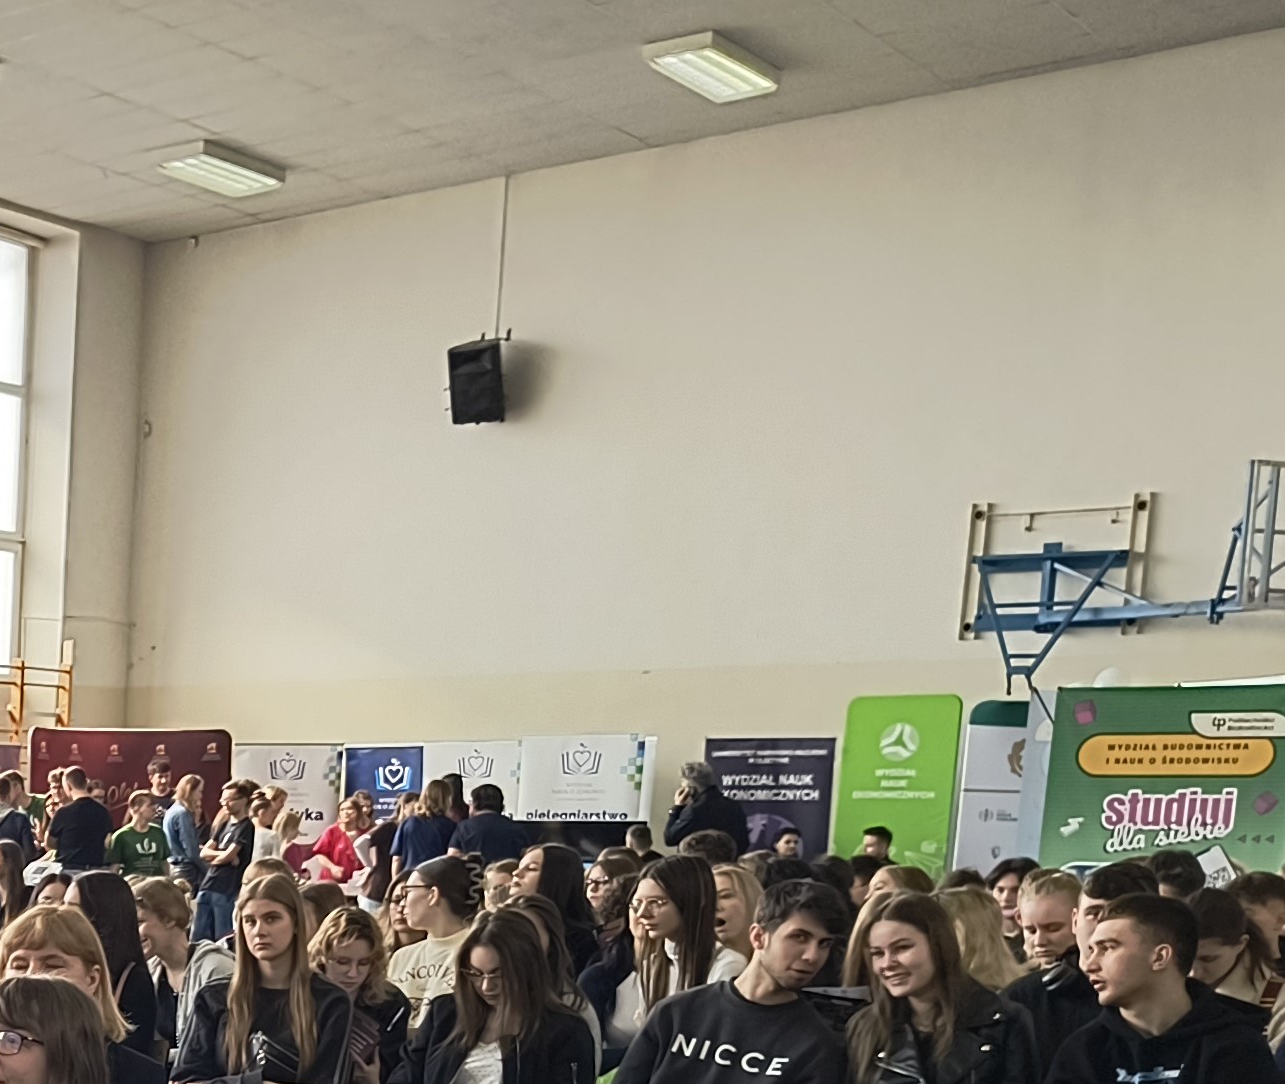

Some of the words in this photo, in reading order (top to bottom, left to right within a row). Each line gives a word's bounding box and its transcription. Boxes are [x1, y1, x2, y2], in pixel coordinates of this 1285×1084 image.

[1107, 743, 1158, 751] WYDZIAŁ
[1162, 742, 1250, 751] BUDOWNICTWA
[1114, 757, 1144, 765] NAUK
[1148, 757, 1157, 765] O
[1161, 755, 1240, 765] ŚRODOWISKU
[721, 774, 776, 786] WYDZIAŁ
[778, 773, 815, 786] NAUK
[1104, 789, 1236, 832] studiuj
[1105, 821, 1146, 852] dla
[1153, 814, 1226, 846] siebie
[670, 1032, 790, 1077] NICCE
